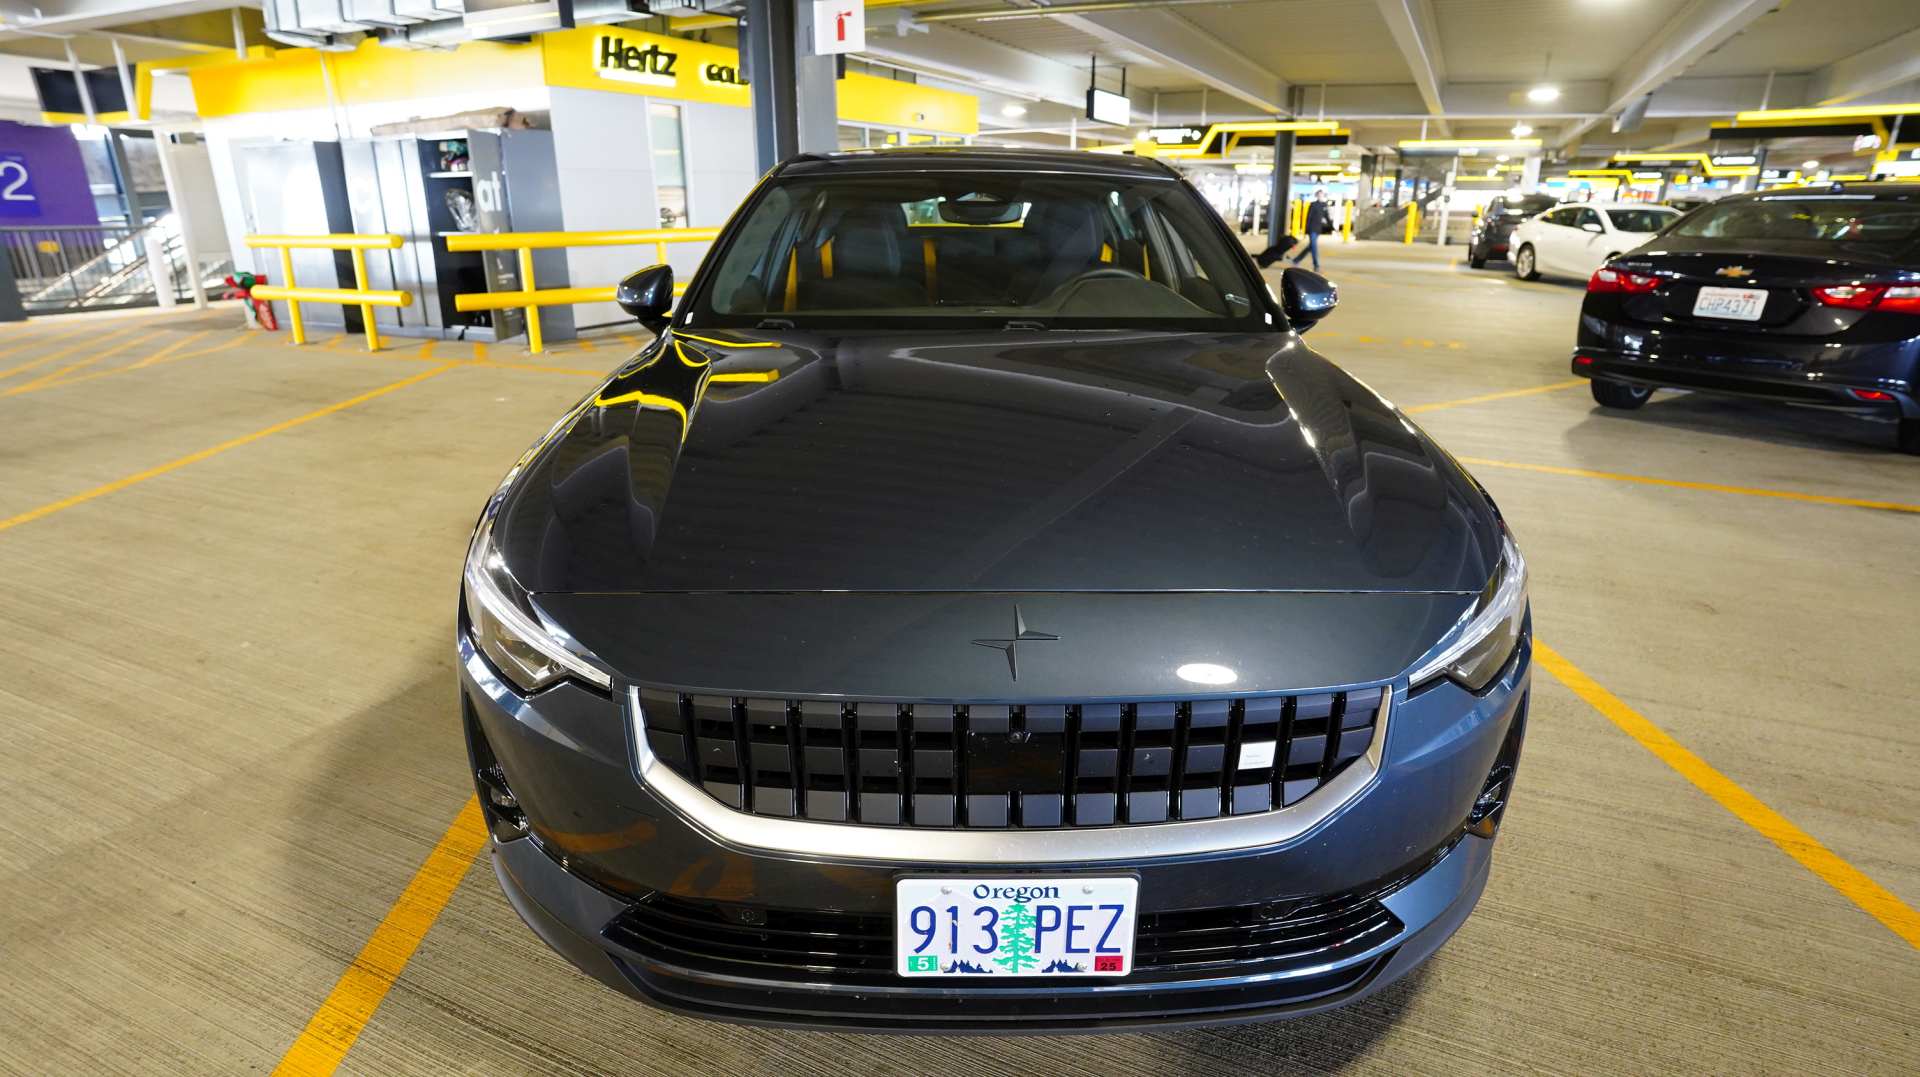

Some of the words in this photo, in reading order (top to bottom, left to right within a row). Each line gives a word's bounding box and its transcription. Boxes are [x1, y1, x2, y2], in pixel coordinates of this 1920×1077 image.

[600, 36, 677, 77] Hertz
[0, 161, 35, 201] 2
[1699, 297, 1757, 314] CHP4371
[973, 884, 1060, 903] Oregon
[910, 905, 999, 954] 913
[1034, 904, 1125, 954] PEZ
[917, 957, 929, 970] 5
